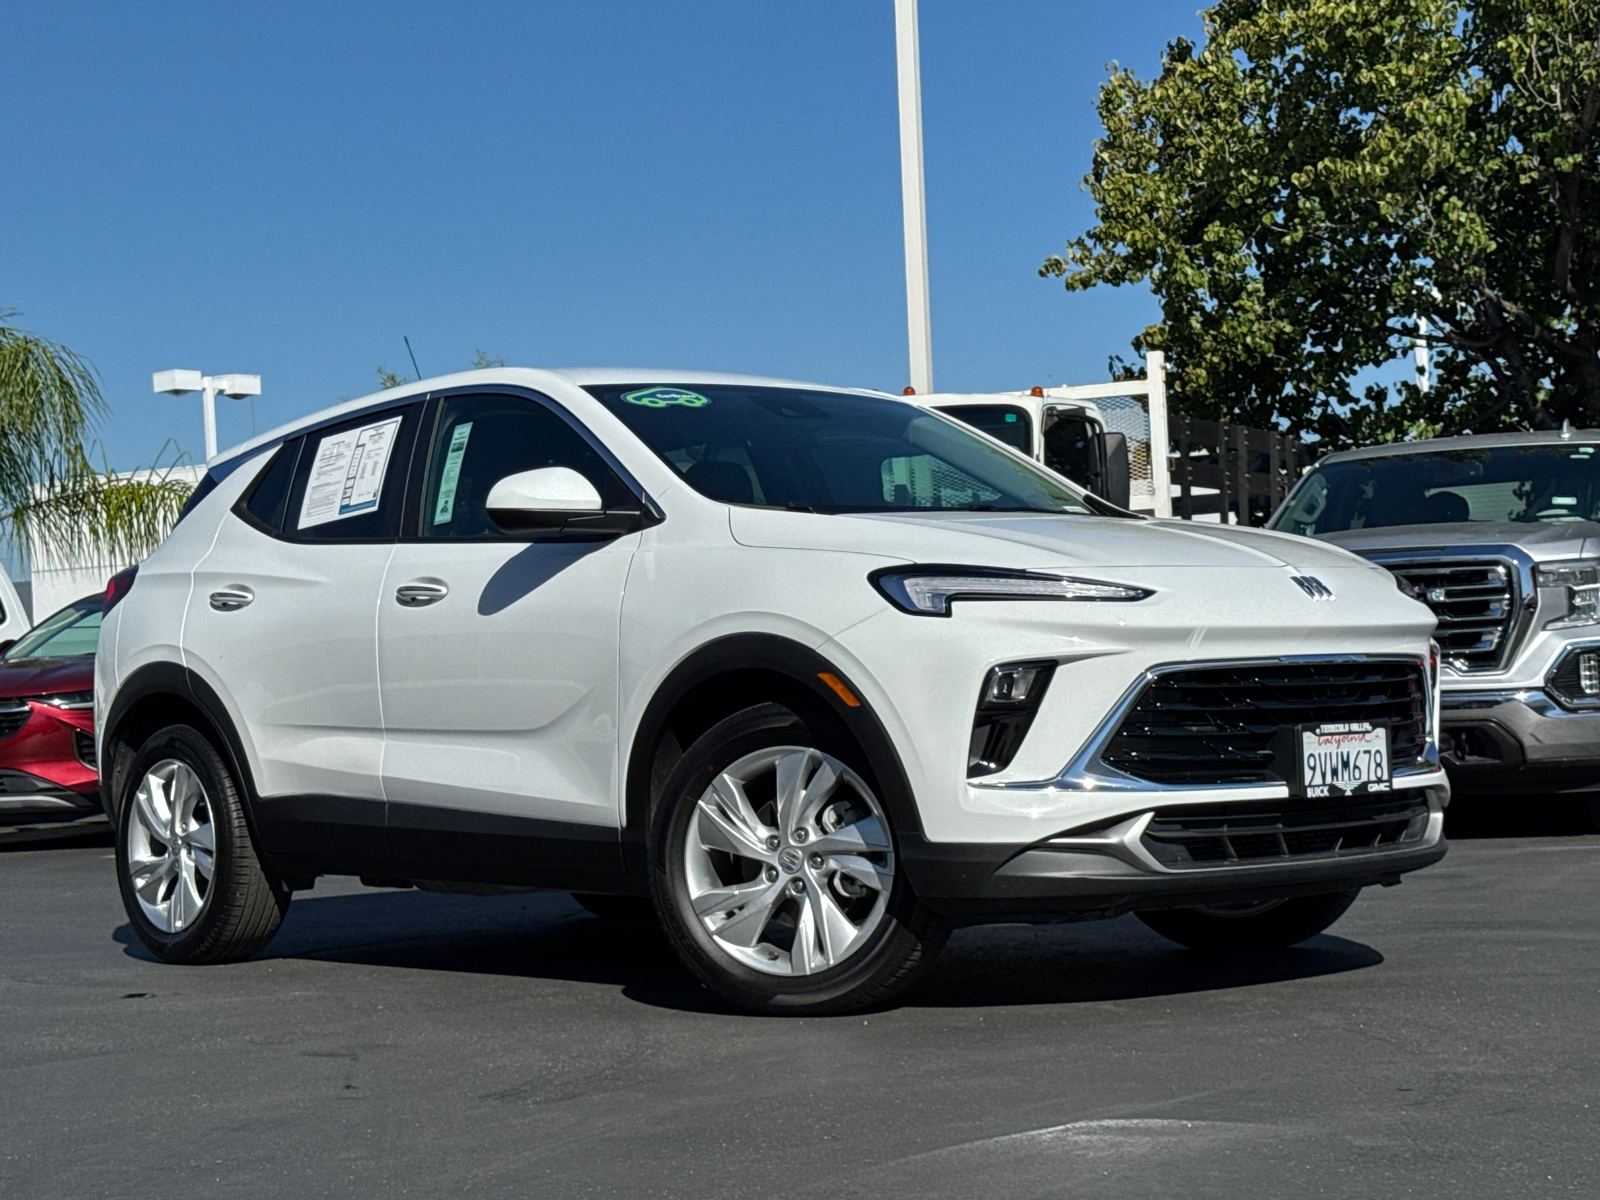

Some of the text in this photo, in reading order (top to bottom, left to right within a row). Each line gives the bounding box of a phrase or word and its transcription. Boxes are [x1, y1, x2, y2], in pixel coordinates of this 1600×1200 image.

[1317, 732, 1372, 750] California
[1306, 749, 1384, 786] 9VWM678
[1307, 785, 1330, 798] BUICK
[1367, 782, 1390, 792] GMC
